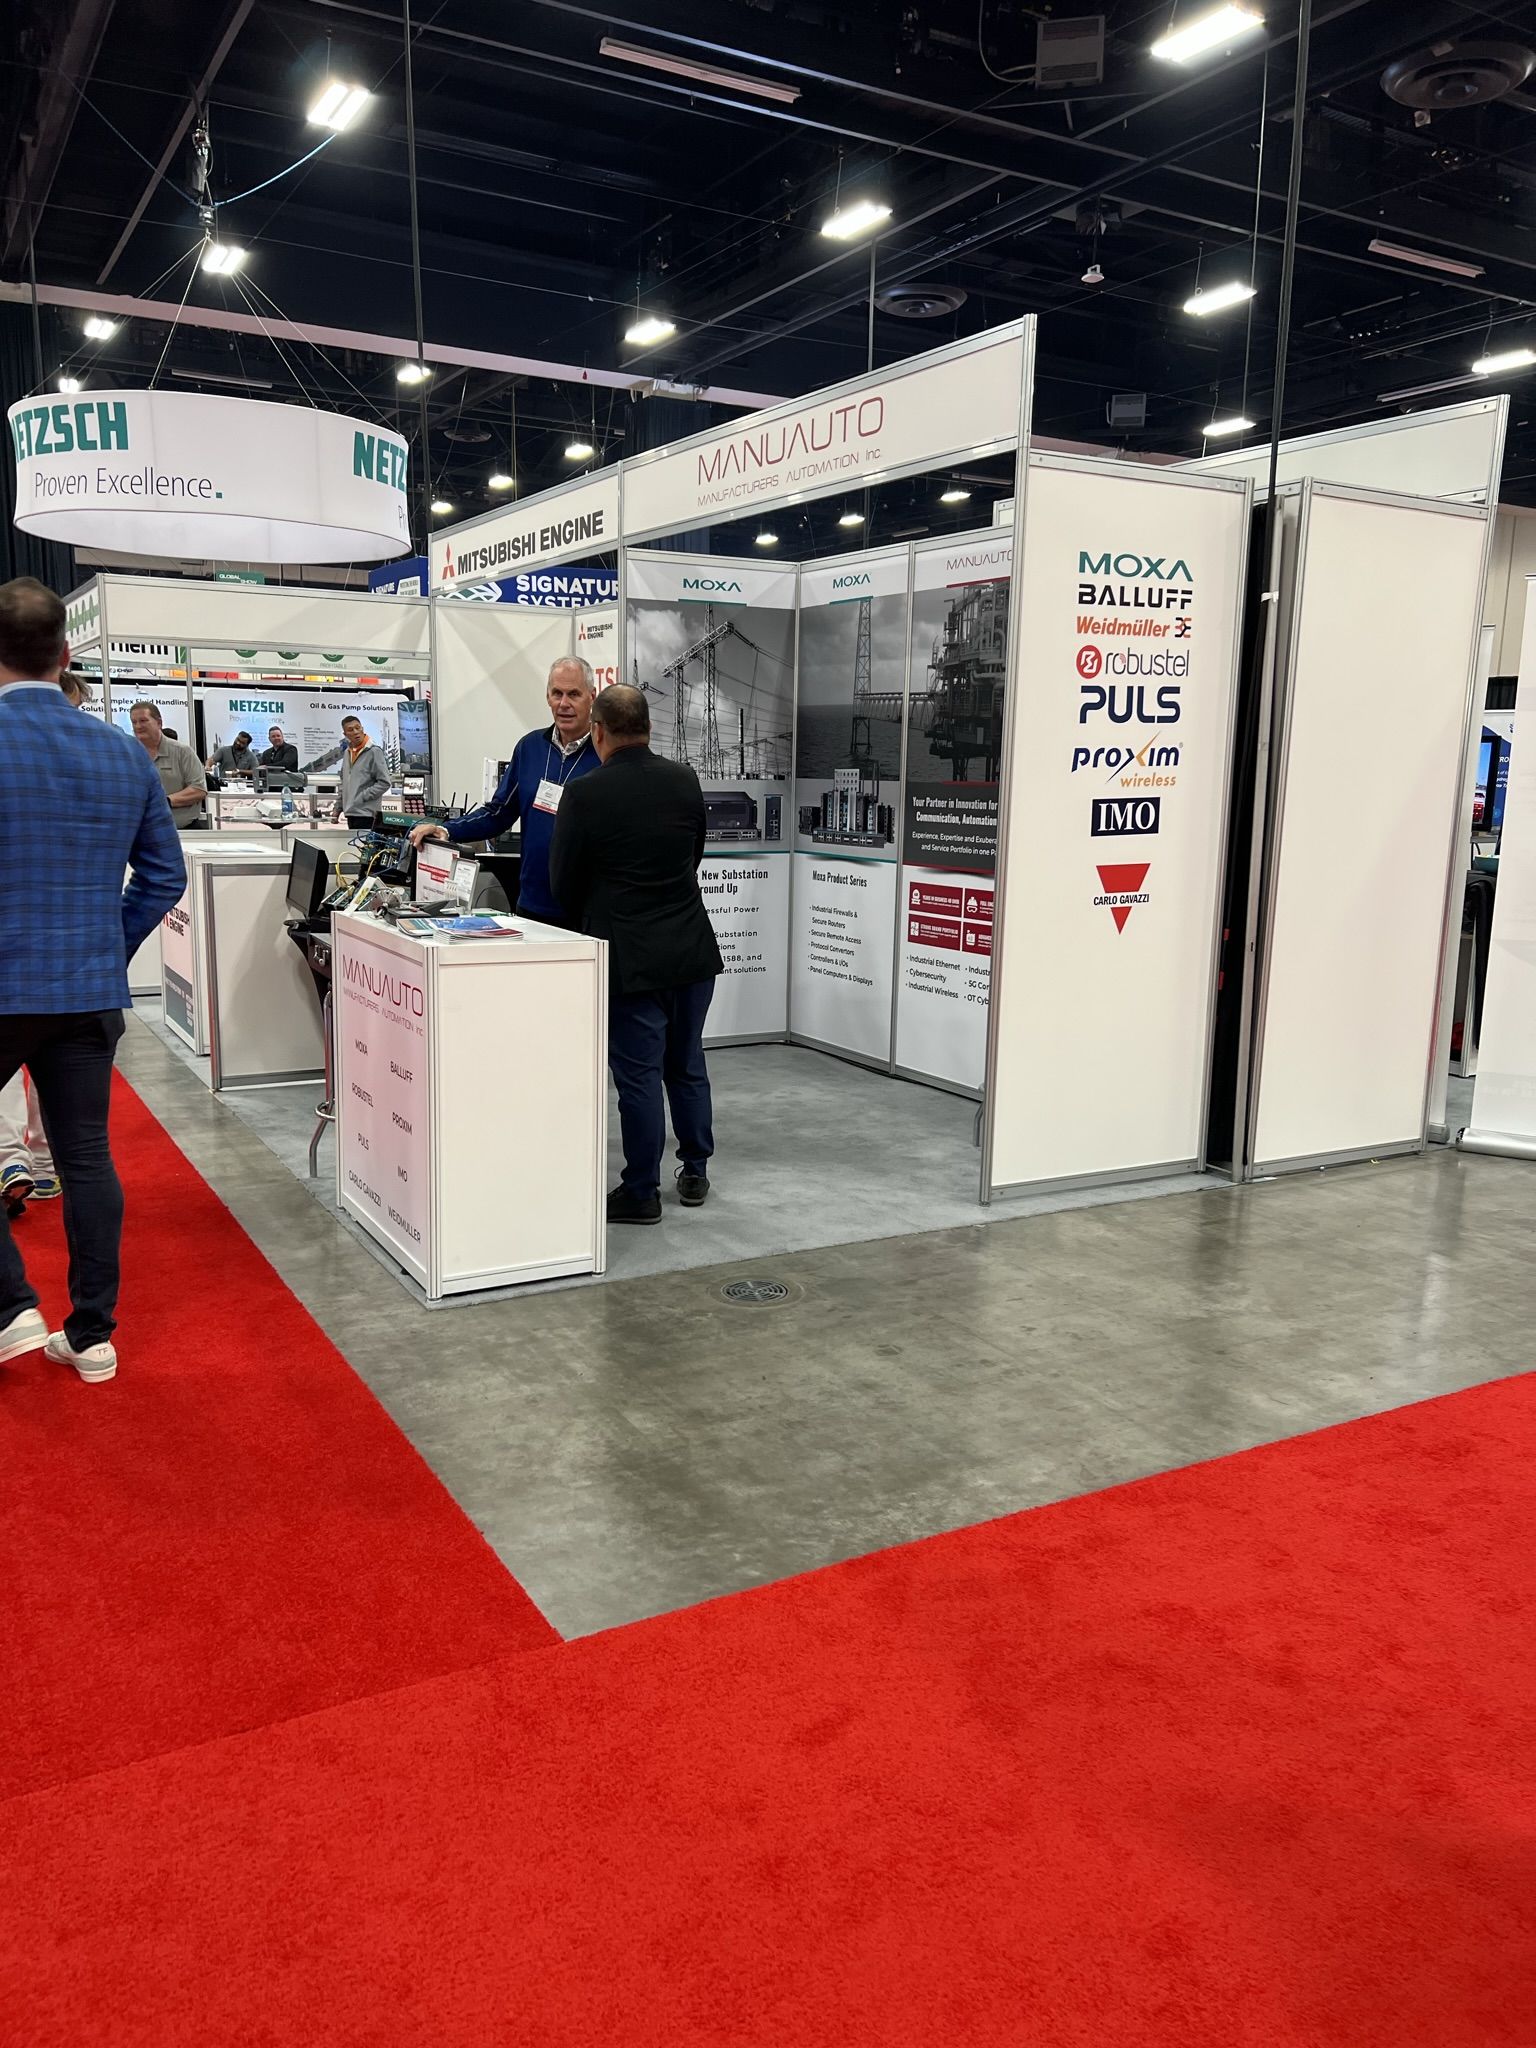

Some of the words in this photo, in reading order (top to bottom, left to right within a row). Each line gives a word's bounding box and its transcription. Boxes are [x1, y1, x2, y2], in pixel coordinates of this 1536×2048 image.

[698, 396, 884, 486] MANUAUTO
[353, 431, 408, 495] NETZ
[35, 472, 88, 498] Proven
[96, 467, 223, 499] Excellence.
[697, 474, 779, 507] MANUFACTURERS
[786, 452, 860, 483] AUTOMATION
[457, 532, 536, 575] MITSUBISHI
[540, 510, 604, 552] ENGINE
[1079, 551, 1194, 582] MOXA
[516, 575, 618, 597] SIGNATUR
[682, 578, 742, 592] MOXA
[832, 574, 871, 589] MOXA
[1078, 583, 1193, 609] BALLUFF
[587, 623, 613, 633] MITSUBISHI
[1077, 615, 1171, 637] Weidmüller
[587, 631, 604, 639] ENGINE
[1105, 647, 1190, 677] robustel
[100, 698, 134, 706] Cmplex
[229, 699, 285, 713] NETZSCH
[362, 704, 394, 712] Solutions
[1079, 685, 1181, 724] PULS
[1120, 772, 1177, 787] wireless
[912, 796, 925, 807] Your
[926, 797, 947, 808] Partner
[948, 798, 954, 808] in
[955, 798, 987, 810] Innovation
[988, 800, 998, 811] for
[385, 816, 405, 824] MOXA
[962, 814, 997, 826] Automation
[1097, 801, 1156, 831] IMO
[940, 833, 964, 842] Expertise
[964, 835, 975, 843] and
[975, 835, 997, 845] Exubera
[931, 844, 949, 852] Service
[950, 845, 972, 854] Portfolio
[701, 870, 719, 880] New
[721, 868, 769, 880] Substation
[812, 869, 826, 882] Moxa
[827, 872, 849, 885] Product
[849, 874, 867, 887] Series
[700, 883, 724, 894] round
[727, 883, 738, 895] Up
[1093, 895, 1118, 906] CARLO
[1119, 893, 1150, 905] GAVAZZI
[811, 904, 833, 914] Industrial
[811, 916, 827, 925] Secure
[827, 919, 846, 929] Routers
[811, 929, 826, 938] Secure
[845, 935, 862, 945] Access
[733, 965, 767, 974] solutions
[909, 954, 935, 966] Industrial
[935, 959, 961, 971] Ethernet
[852, 975, 873, 986] Displays
[909, 968, 947, 983] Cybersecurity
[342, 953, 424, 1017] MANUAUTO
[908, 981, 934, 993] Industrial
[934, 987, 959, 999] Wireless
[355, 1039, 368, 1056] MOXA
[390, 1061, 413, 1084] BALLUFF
[352, 1082, 374, 1108] ROBUSTEL
[392, 1111, 413, 1135] PROXIM
[358, 1132, 370, 1150] PULS
[348, 1170, 363, 1190] CARLO
[397, 1165, 408, 1182] IMO
